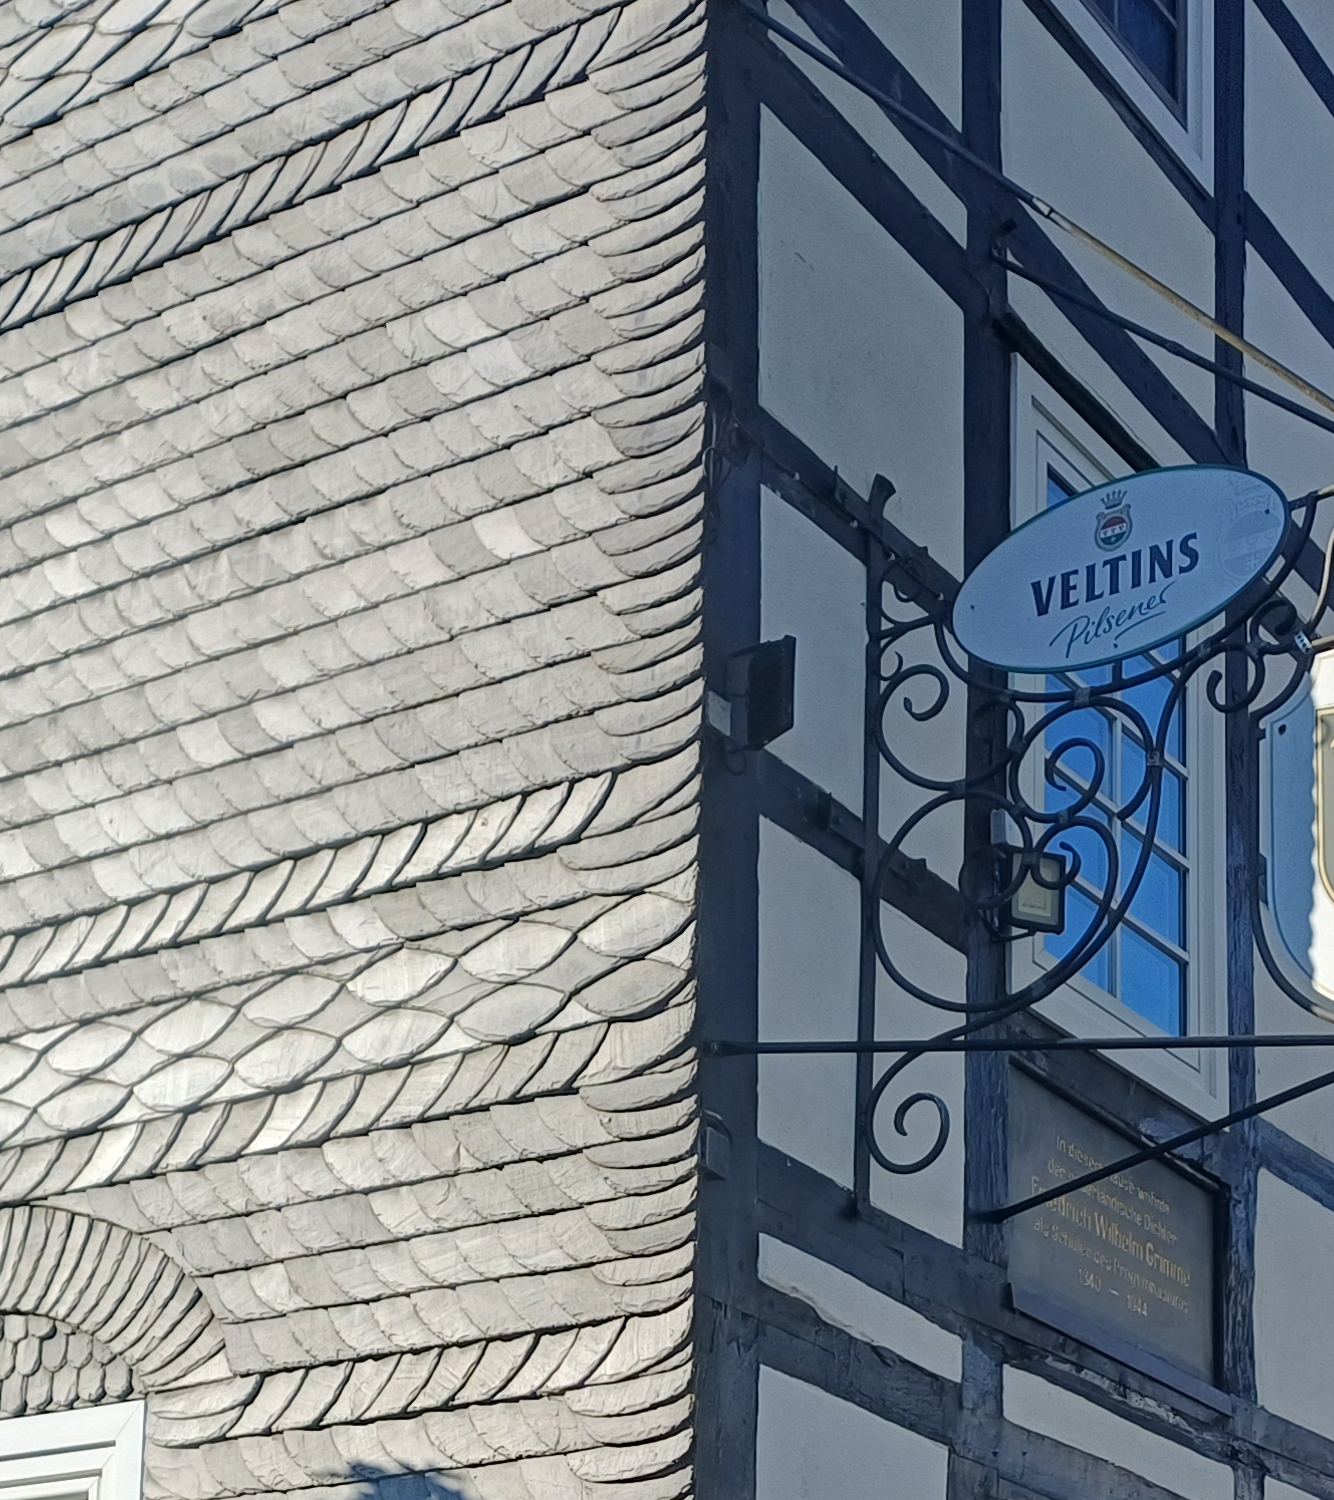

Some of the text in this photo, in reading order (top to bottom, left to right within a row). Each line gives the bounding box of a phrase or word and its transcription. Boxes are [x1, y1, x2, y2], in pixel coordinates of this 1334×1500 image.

[1030, 532, 1199, 617] VELTINS
[1049, 580, 1177, 659] Pilsener
[1094, 1211, 1144, 1261] Wilhelm
[1146, 1242, 1191, 1287] Grimme
